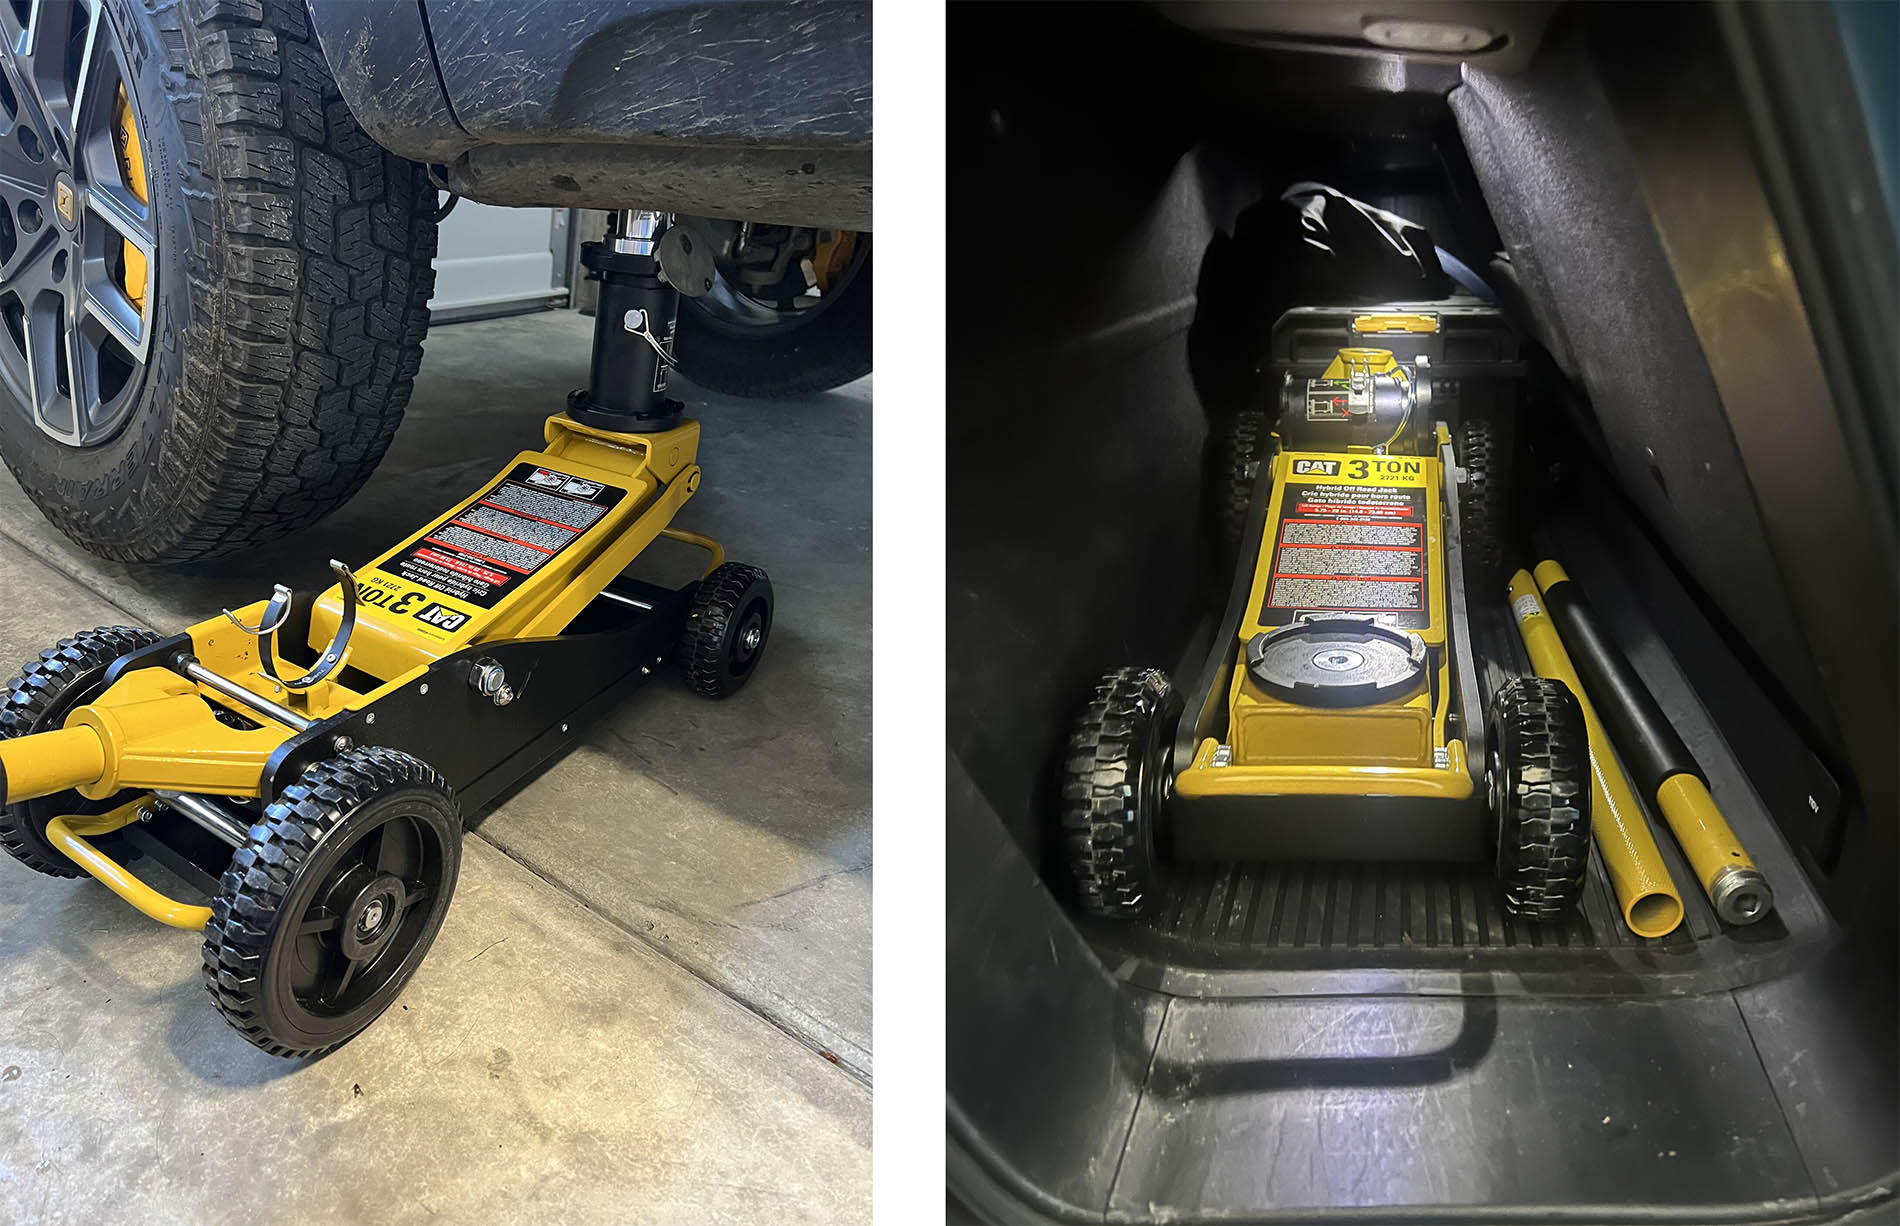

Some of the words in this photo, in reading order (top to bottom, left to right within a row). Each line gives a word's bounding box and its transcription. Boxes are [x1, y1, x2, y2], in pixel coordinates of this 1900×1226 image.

[1296, 461, 1336, 475] CAT
[1348, 460, 1369, 479] 3
[1372, 461, 1420, 473] TON
[400, 562, 418, 570] route
[401, 571, 419, 580] Jack
[416, 577, 436, 586] Road
[431, 573, 450, 581] pour
[383, 582, 402, 591] 2721
[447, 578, 475, 591] hybride
[444, 586, 470, 599] Hybrid
[388, 592, 426, 614] 3
[418, 606, 465, 629] CAT
